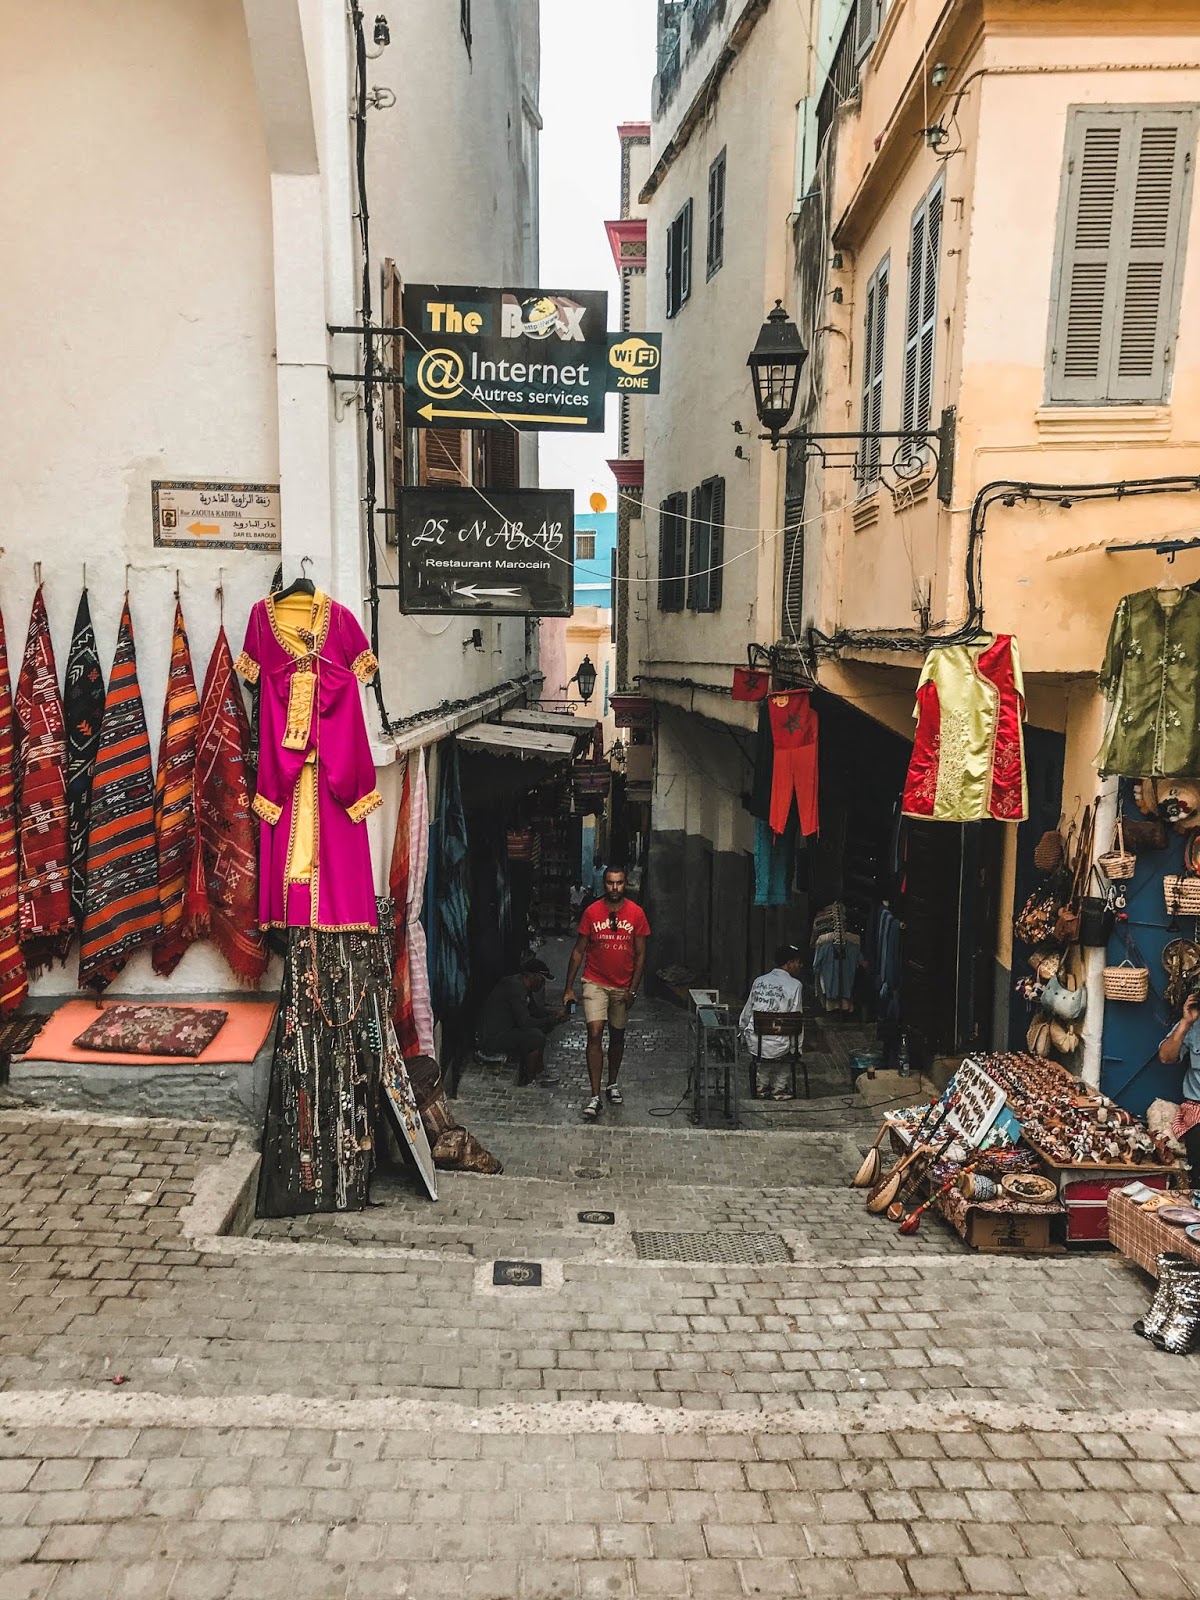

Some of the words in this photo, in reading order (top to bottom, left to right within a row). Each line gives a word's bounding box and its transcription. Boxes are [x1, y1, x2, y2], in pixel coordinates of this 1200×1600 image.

[426, 302, 483, 334] The
[501, 294, 587, 341] BOX
[471, 352, 590, 386] Internet
[616, 376, 649, 389] ZONE
[471, 385, 523, 403] Autres
[528, 391, 589, 406] services
[255, 494, 271, 507] زنقة
[191, 509, 215, 517] ZAOUIA
[260, 520, 276, 530] دار
[411, 518, 449, 547] LE
[425, 558, 492, 569] Restaurant
[495, 559, 550, 570] Marocain
[593, 917, 634, 934] Holister
